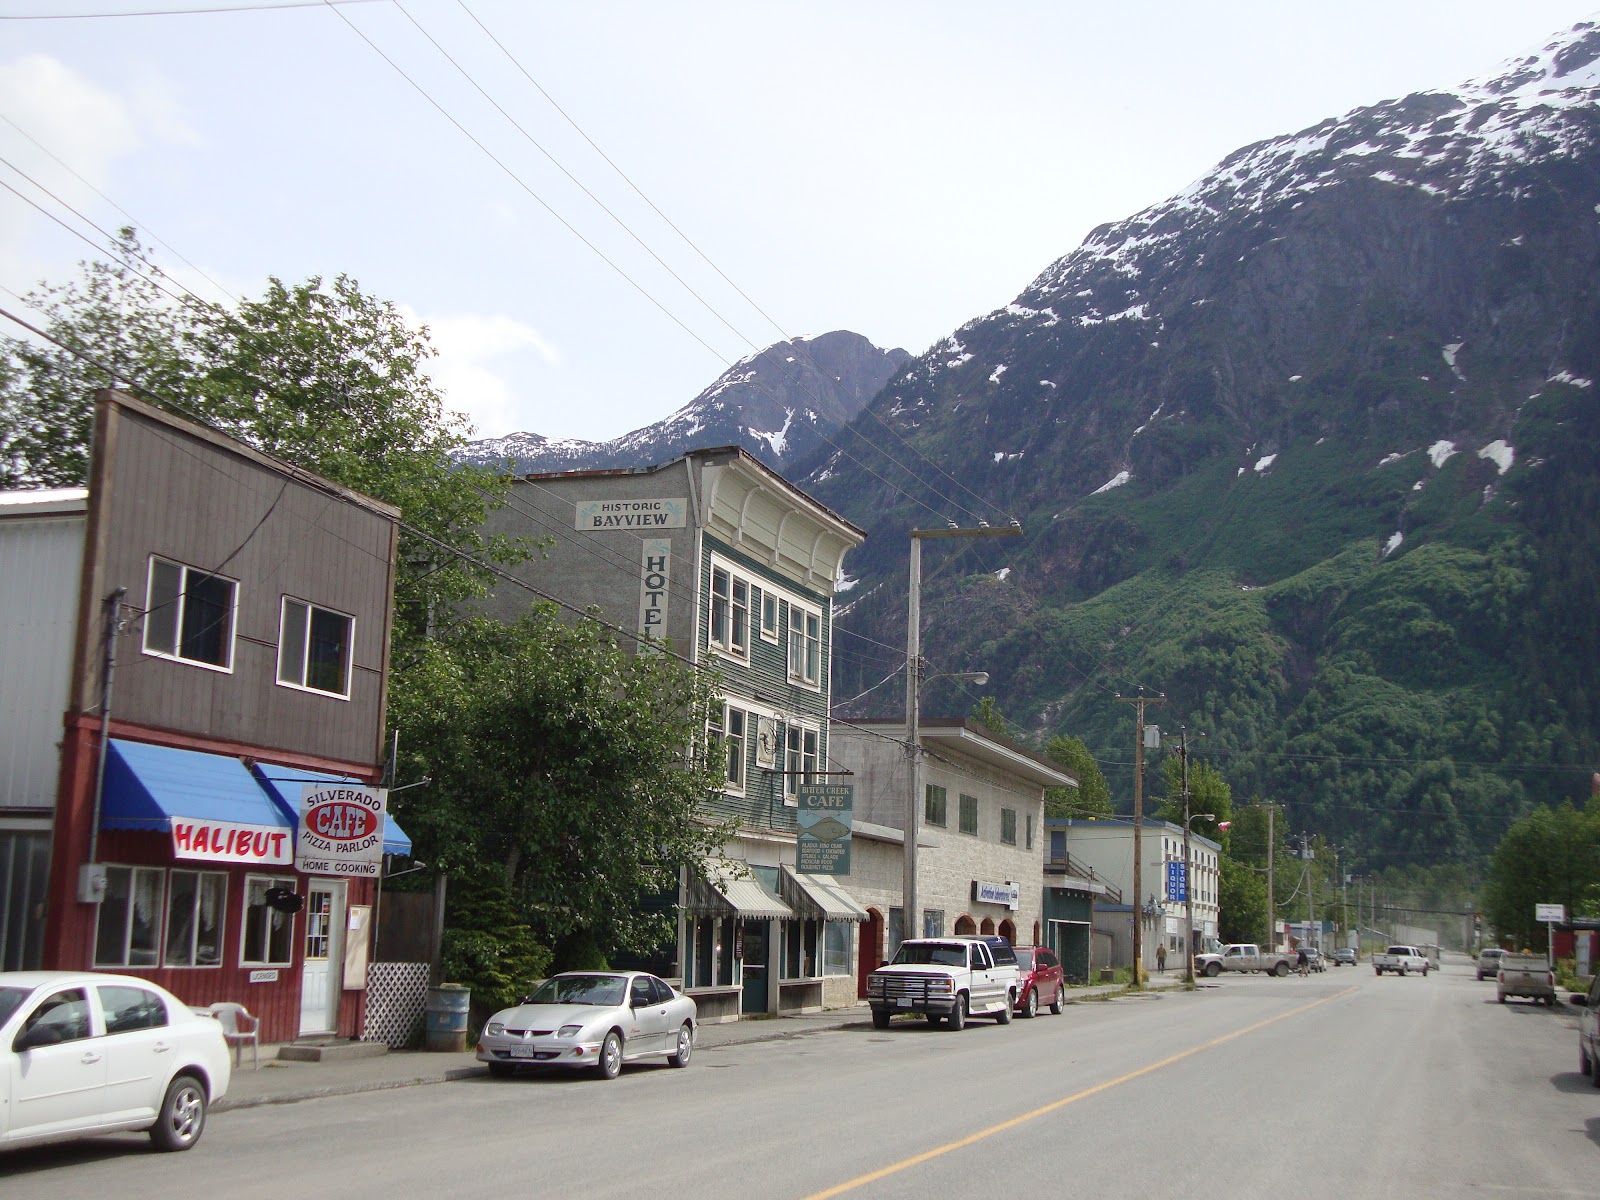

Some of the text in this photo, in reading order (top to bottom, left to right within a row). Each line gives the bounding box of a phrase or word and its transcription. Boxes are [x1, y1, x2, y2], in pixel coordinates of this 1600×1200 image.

[602, 502, 661, 512] HISTORIC
[593, 513, 668, 527] BAYVIEW
[644, 556, 666, 641] HOTEL
[802, 786, 849, 795] BITTER CREEK
[307, 789, 381, 811] SILVERADO
[807, 795, 844, 807] CAFE
[316, 805, 367, 838] CAFE
[175, 824, 286, 858] HALIBUT
[302, 831, 379, 853] PIZZA PARLOR
[302, 861, 376, 874] HOME COOKING
